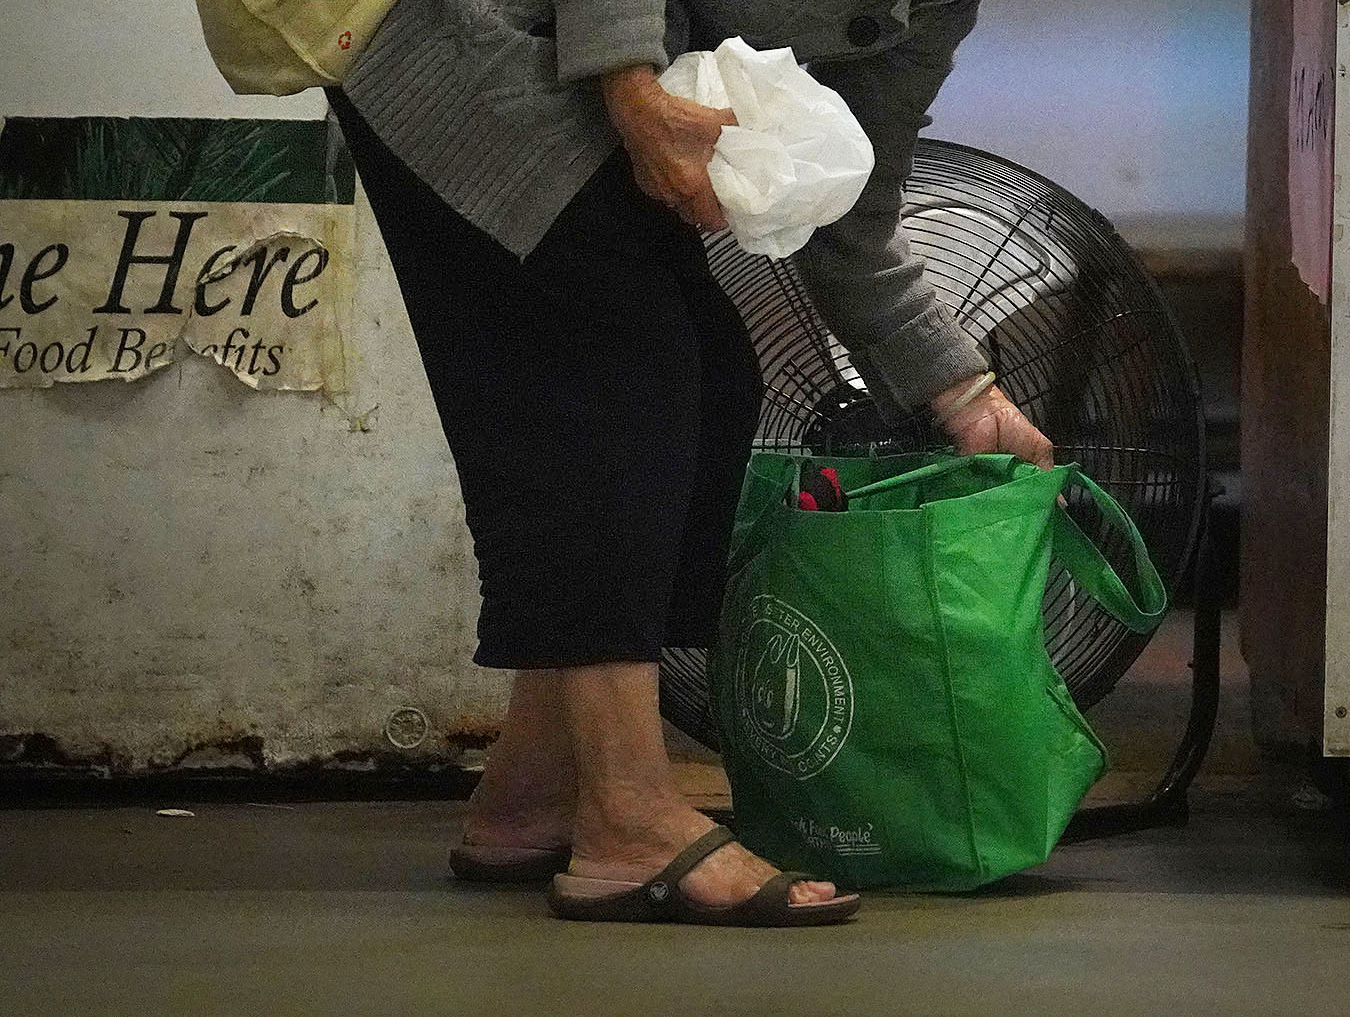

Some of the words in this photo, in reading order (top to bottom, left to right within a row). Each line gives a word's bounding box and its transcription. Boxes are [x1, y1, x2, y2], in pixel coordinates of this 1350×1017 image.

[0, 242, 69, 315] e
[92, 210, 330, 319] Here
[106, 326, 284, 377] Befits
